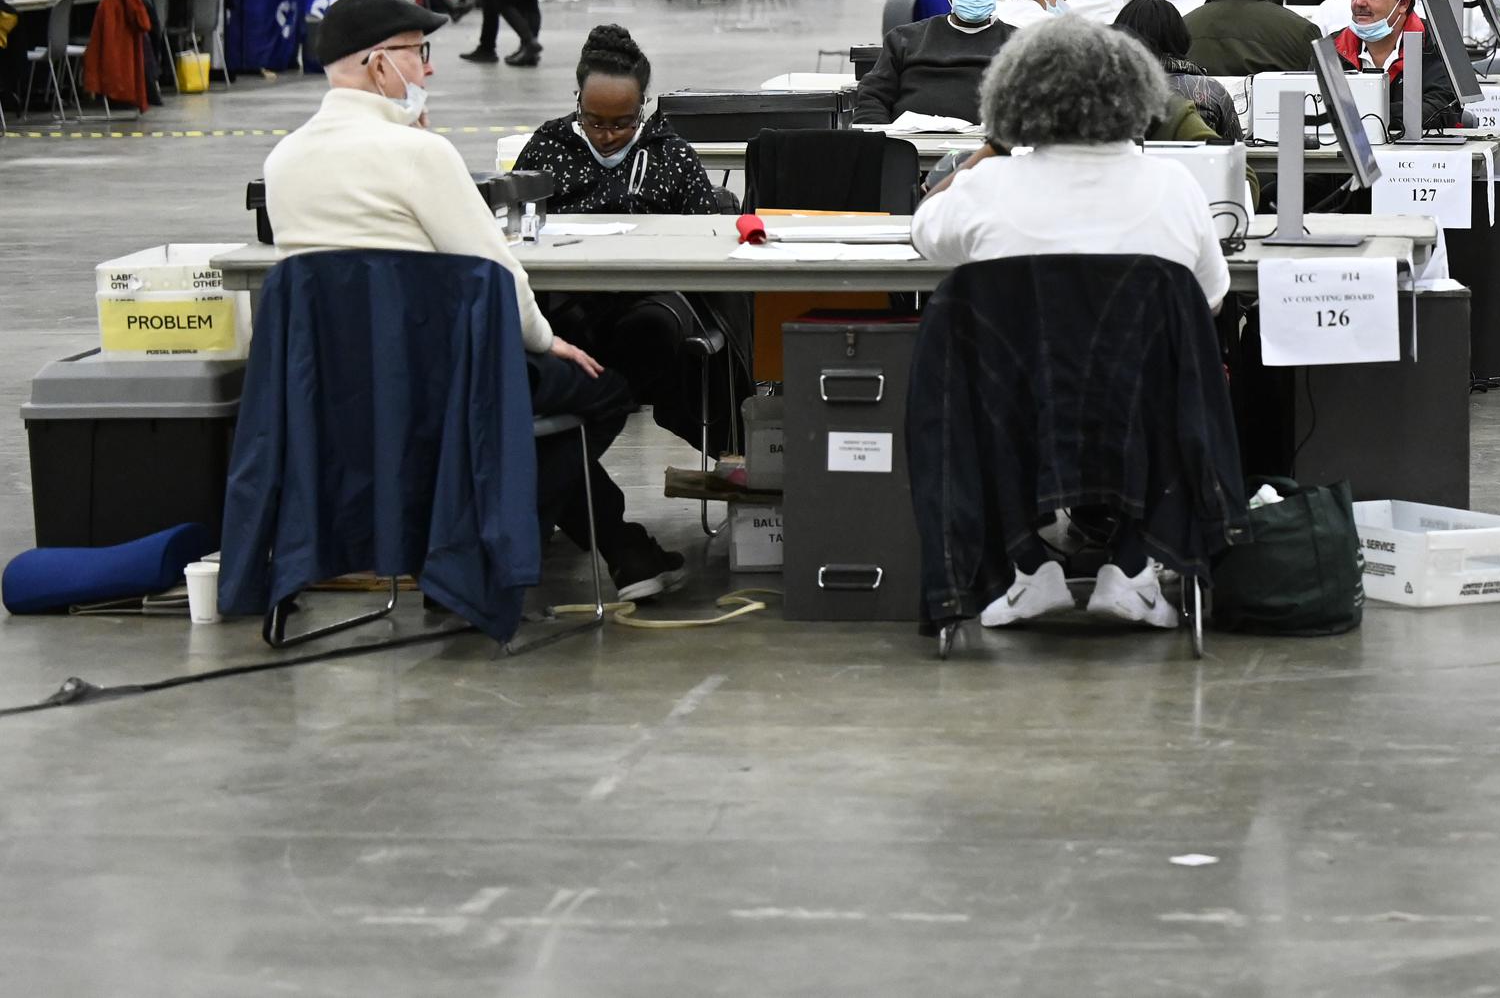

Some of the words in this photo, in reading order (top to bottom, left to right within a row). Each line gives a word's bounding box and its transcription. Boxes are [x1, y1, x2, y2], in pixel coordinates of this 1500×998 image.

[1477, 116, 1496, 127] 128
[1398, 161, 1415, 169] ICC
[1412, 188, 1437, 202] 127
[1294, 272, 1319, 284] ICC
[1341, 271, 1361, 282] #14
[110, 282, 129, 290] OTH
[1282, 296, 1295, 304] AV
[1296, 294, 1342, 303] COUNTING
[1344, 293, 1375, 302] BOARD
[127, 314, 213, 330] PROBLEM
[1315, 308, 1351, 328] 126
[769, 443, 784, 453] BA
[753, 518, 784, 528] BALL
[768, 533, 784, 543] TA
[1366, 538, 1396, 552] SERVICE
